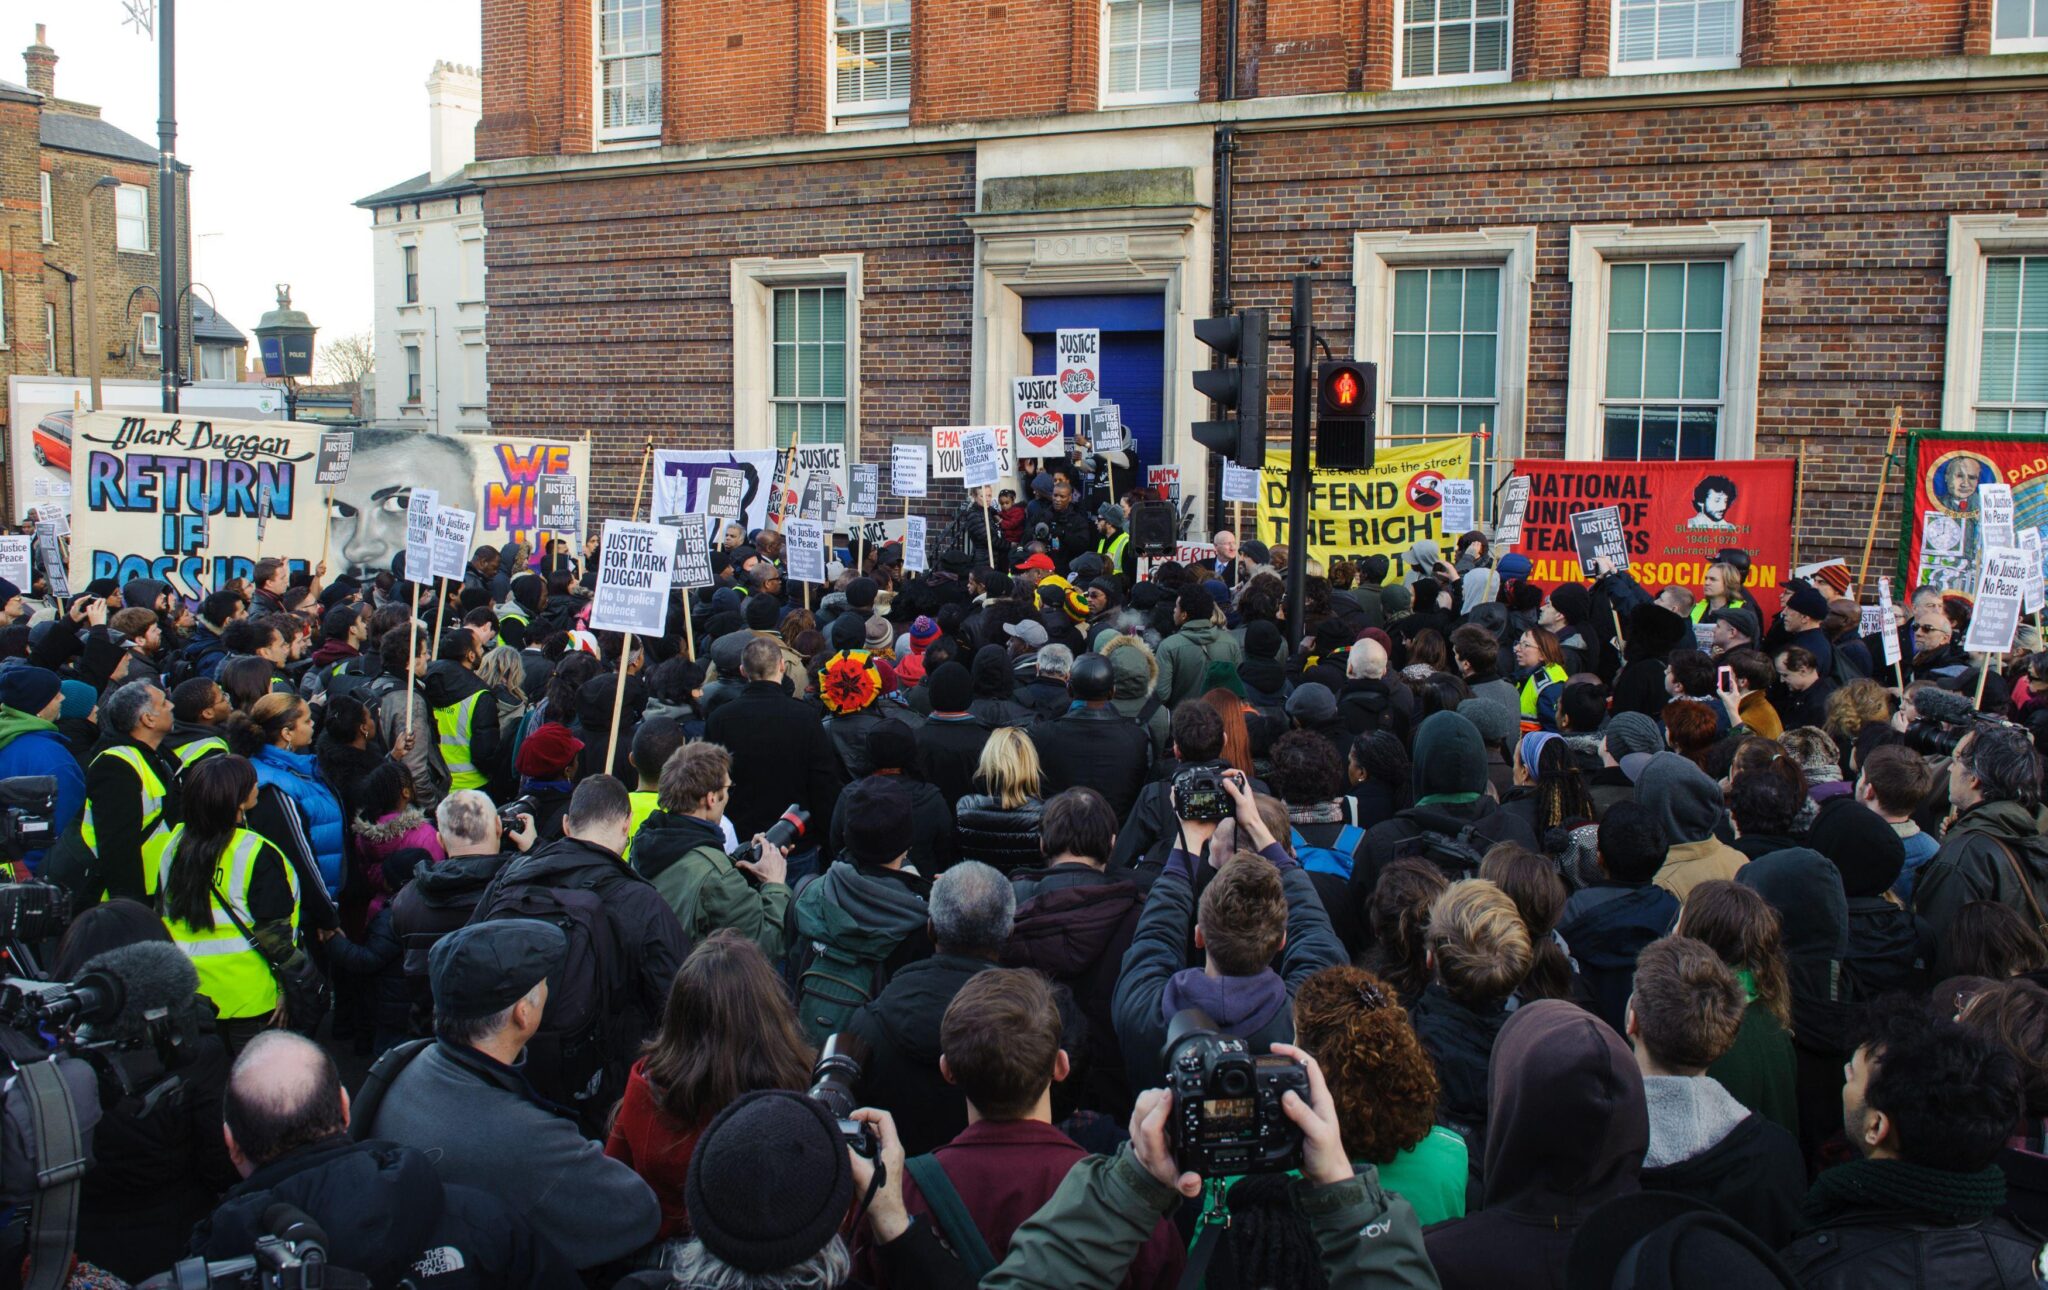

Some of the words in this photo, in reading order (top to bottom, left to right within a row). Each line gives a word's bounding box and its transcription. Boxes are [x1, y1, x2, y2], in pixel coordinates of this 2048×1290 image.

[1038, 236, 1126, 259] POLICE
[1067, 355, 1087, 363] FOR
[1027, 400, 1049, 409] FOR
[1095, 413, 1118, 423] JUSTICE
[1106, 422, 1118, 430] FOR
[84, 416, 187, 450] Mark
[184, 421, 315, 462] Duggan
[1101, 430, 1119, 439] MARK
[324, 441, 351, 452] JUSTICE
[962, 436, 986, 449] JUSTICE
[1096, 439, 1120, 449] DUGGAN
[964, 448, 975, 458] FOR
[976, 444, 994, 454] MARK
[494, 443, 570, 485] WE
[965, 454, 989, 466] DUGGAN
[1375, 464, 1398, 475] rule
[1401, 462, 1420, 472] the
[1424, 455, 1462, 470] street
[2007, 456, 2048, 483] PAD
[715, 476, 741, 487] JUSTICE
[854, 472, 876, 483] JUSTICE
[88, 450, 296, 520] RETURN
[545, 483, 575, 494] JUSTICE
[727, 487, 740, 496] FOR
[864, 483, 876, 492] FOR
[1452, 486, 1471, 496] Justice
[1527, 473, 1652, 499] NATIONAL
[560, 495, 575, 504] FOR
[719, 496, 739, 506] MARK
[858, 493, 876, 503] MARK
[1267, 481, 1399, 512] DFEND
[1444, 496, 1452, 504] No
[1452, 496, 1469, 505] Peace
[1984, 495, 1992, 508] No
[1994, 494, 2012, 508] Justice
[552, 505, 575, 515] MARK
[711, 504, 738, 516] DUGGAN
[851, 502, 875, 513] DUGGAN
[1525, 501, 1604, 525] UNI
[1617, 502, 1648, 527] OF
[438, 514, 446, 526] No
[447, 515, 470, 532] Justice
[543, 515, 574, 525] DUGGAN
[1984, 510, 1992, 523] No
[1994, 510, 2009, 523] Peace
[677, 524, 704, 539] STICE
[788, 525, 796, 536] No
[798, 527, 820, 538] Justice
[1268, 516, 1336, 546] TE
[1350, 512, 1450, 546] RIGH
[1581, 517, 1619, 535] JUSTICE
[1675, 524, 1708, 533] BLAIR
[1712, 524, 1750, 534] PEACH
[162, 513, 209, 556] IF
[436, 526, 444, 537] No
[445, 528, 464, 543] Peace
[1523, 527, 1651, 554] TEARS
[1601, 529, 1621, 544] FOR
[1686, 535, 1737, 544] 1946-1979
[0, 543, 27, 552] Justice
[606, 533, 653, 553] JUSTICE
[685, 539, 706, 553] FOR
[788, 536, 797, 546] No
[798, 538, 818, 549] Peace
[1594, 541, 1623, 557] MARK
[0, 554, 24, 562] Peace
[605, 551, 628, 568] FOR
[632, 553, 667, 572] MARK
[677, 553, 707, 568] MARK
[1586, 553, 1626, 571] DAN
[1527, 559, 1596, 583] ALIN
[1986, 559, 1999, 575] No
[1999, 561, 2025, 579] Justice
[93, 550, 311, 605] POSSIB
[603, 568, 652, 588] DUGGAN
[1982, 578, 1994, 595] No
[1995, 579, 2018, 596] Peace
[601, 589, 614, 600] No
[616, 591, 625, 601] to
[628, 592, 655, 606] police
[599, 602, 636, 616] violence
[424, 1248, 445, 1260] THE
[421, 1264, 448, 1278] FACE
